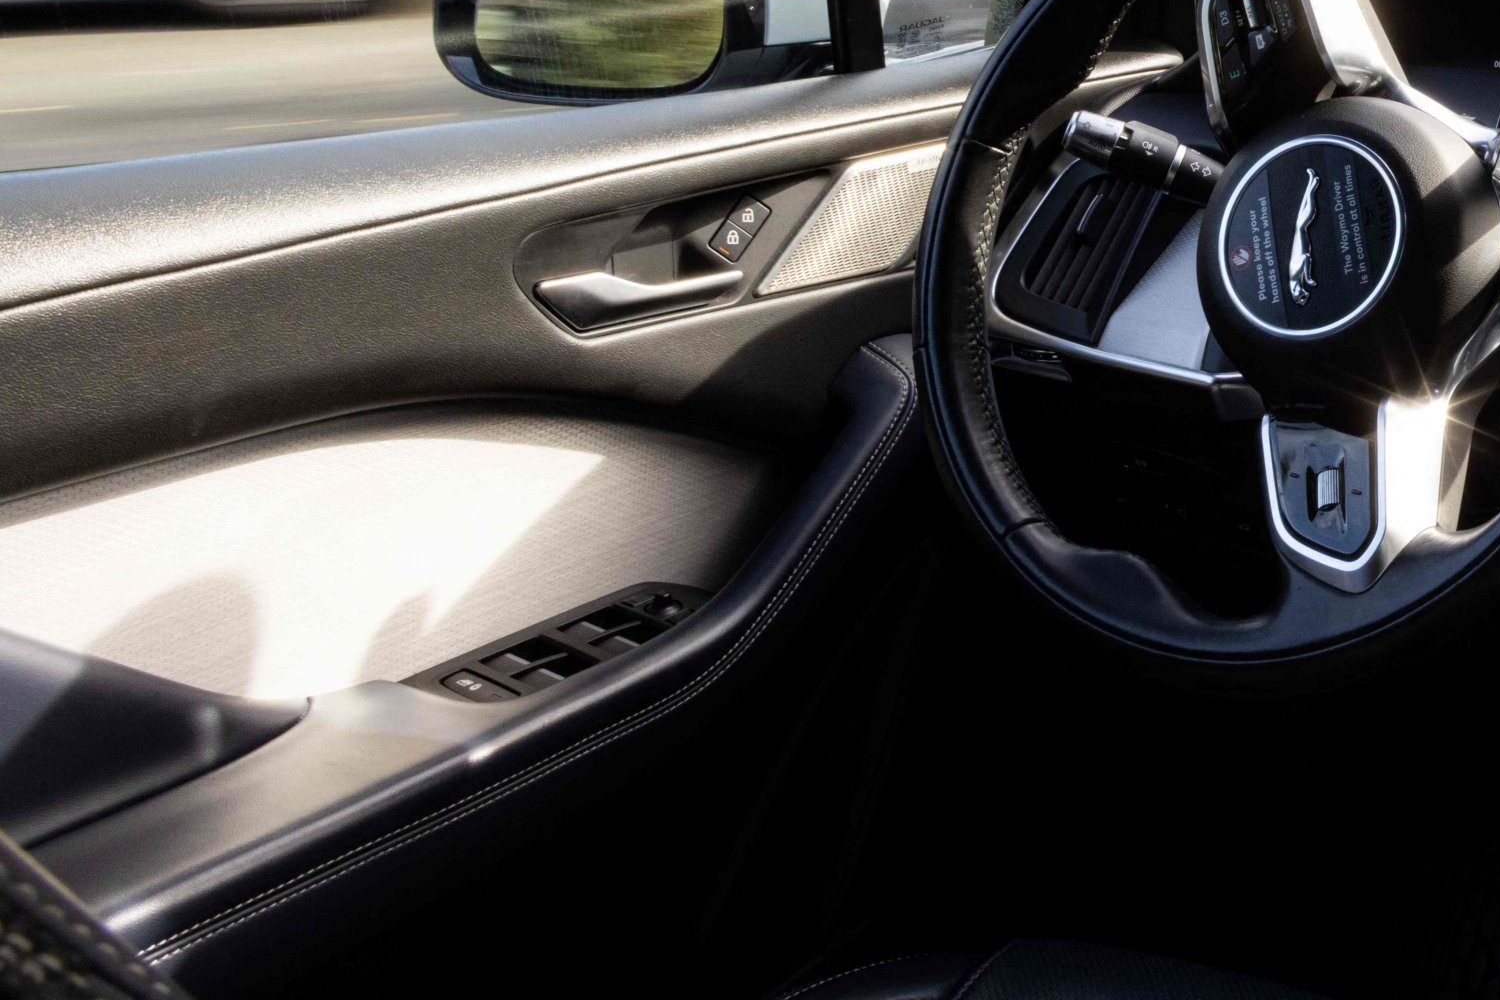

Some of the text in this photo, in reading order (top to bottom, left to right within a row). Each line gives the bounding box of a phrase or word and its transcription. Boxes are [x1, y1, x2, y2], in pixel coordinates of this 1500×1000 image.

[1219, 10, 1230, 26] D3
[1250, 210, 1267, 301] Please keep your
[1258, 196, 1279, 304] hands off the wheel
[1333, 180, 1353, 275] The Waymo Driver
[1345, 164, 1369, 285] is in control at all times
